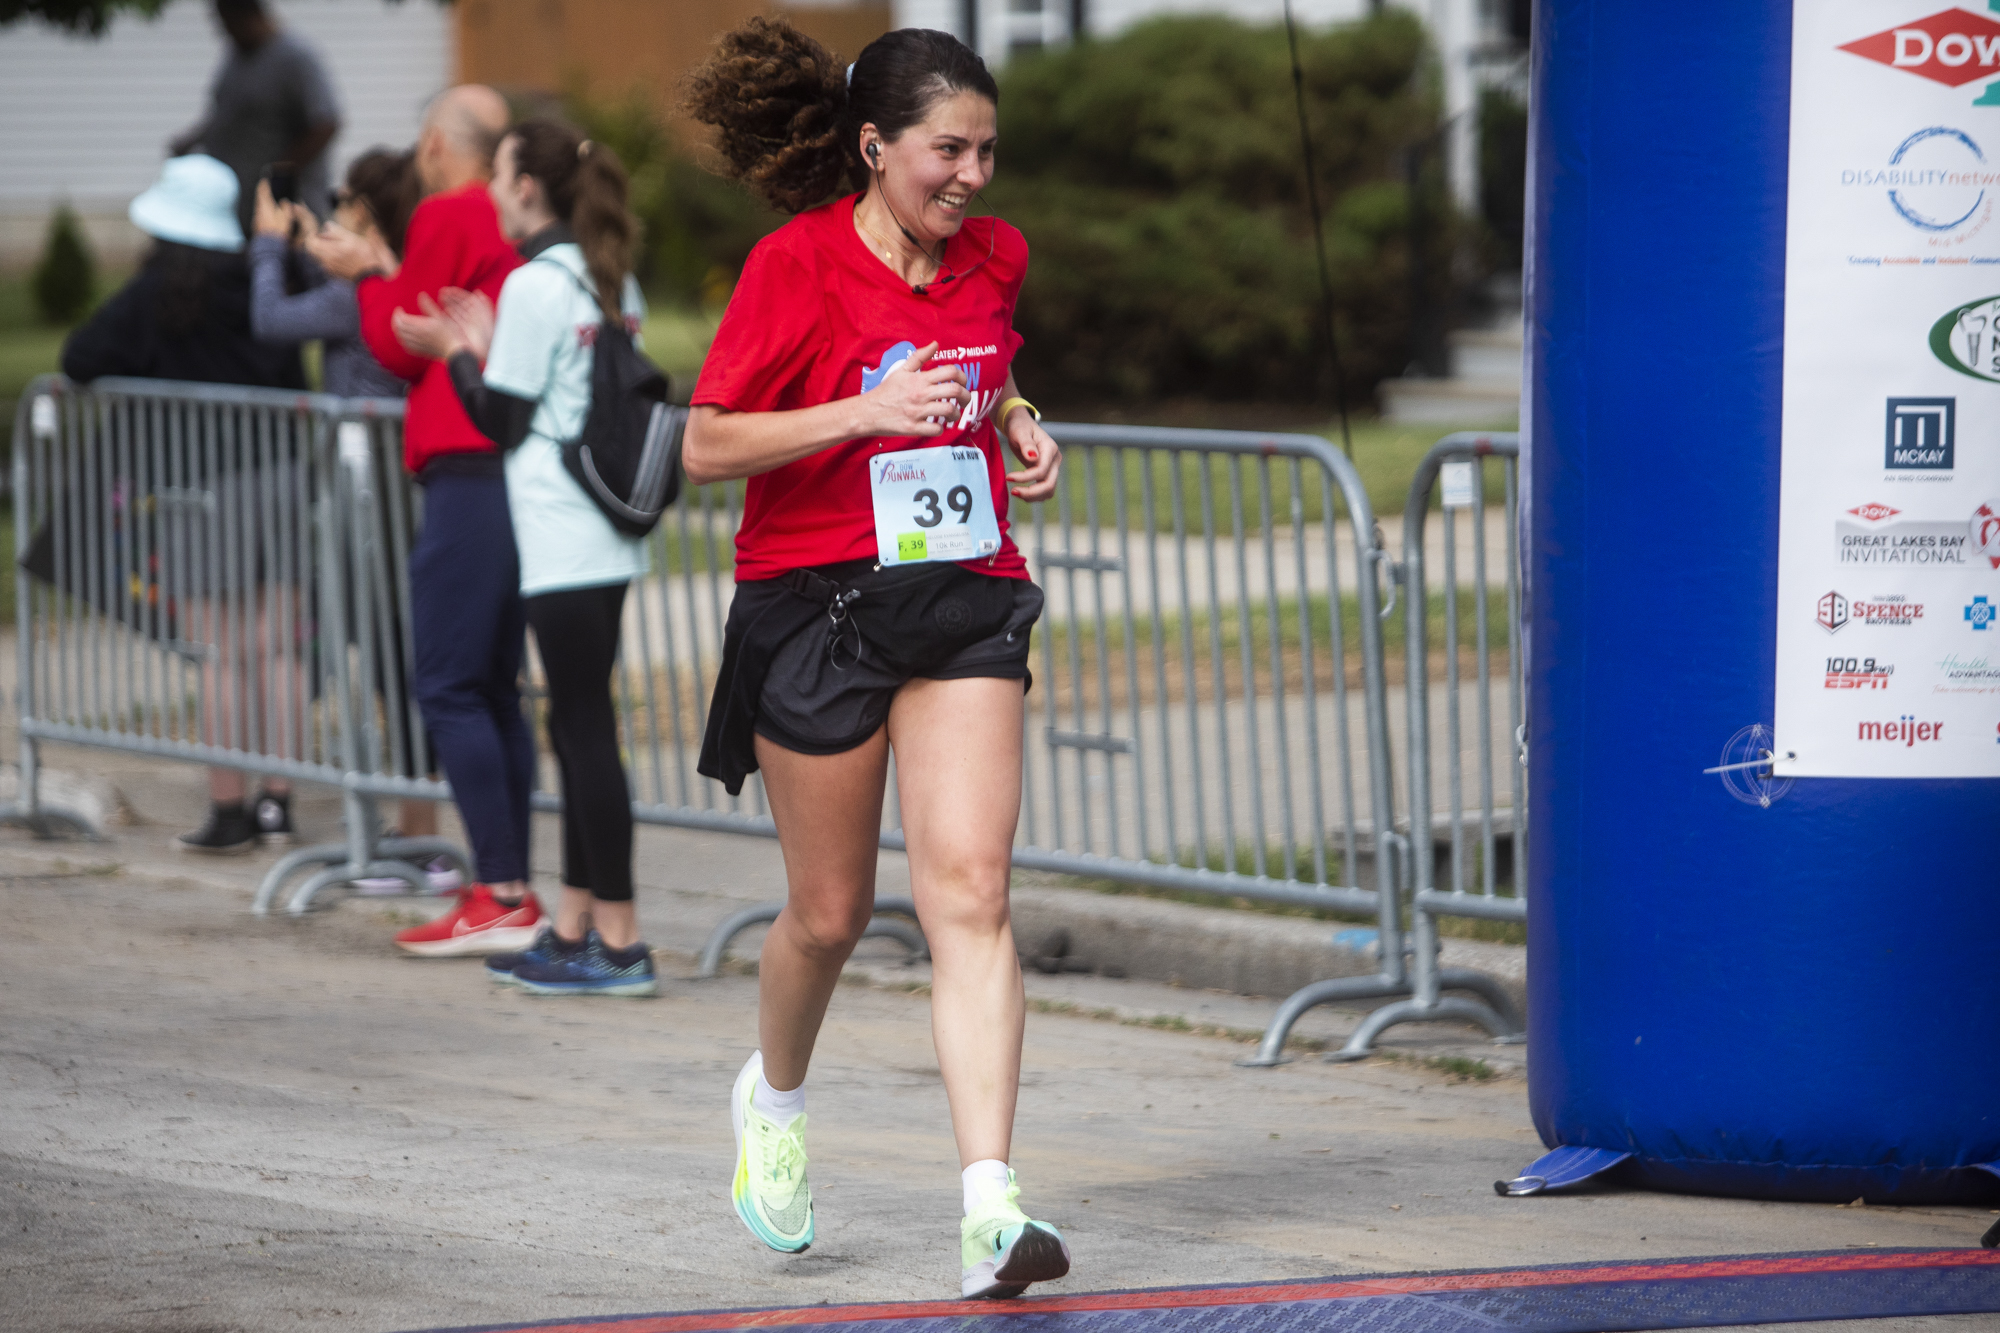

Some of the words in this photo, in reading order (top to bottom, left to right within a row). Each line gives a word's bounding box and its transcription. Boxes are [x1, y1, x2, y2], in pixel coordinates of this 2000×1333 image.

[931, 349, 958, 361] EATER
[966, 344, 997, 357] MIDLAND
[952, 451, 966, 461] 10K
[966, 450, 980, 460] RUN
[1893, 448, 1946, 465] MCKAY
[899, 463, 914, 471] DOW
[913, 484, 973, 527] 39
[1858, 505, 1892, 518] DOW
[910, 539, 924, 550] 39
[1842, 535, 1889, 546] GREAT
[1892, 535, 1937, 547] LAKES
[1940, 535, 1966, 547] BAY
[1841, 548, 1967, 564] INVITATIONAL
[1853, 601, 1924, 618] SPENCE
[1865, 617, 1912, 625] BROTHERS
[1825, 657, 1876, 673] 100.9
[1934, 652, 1992, 676] Health
[1824, 672, 1889, 689] ESPN
[1857, 715, 1944, 747] meijer
